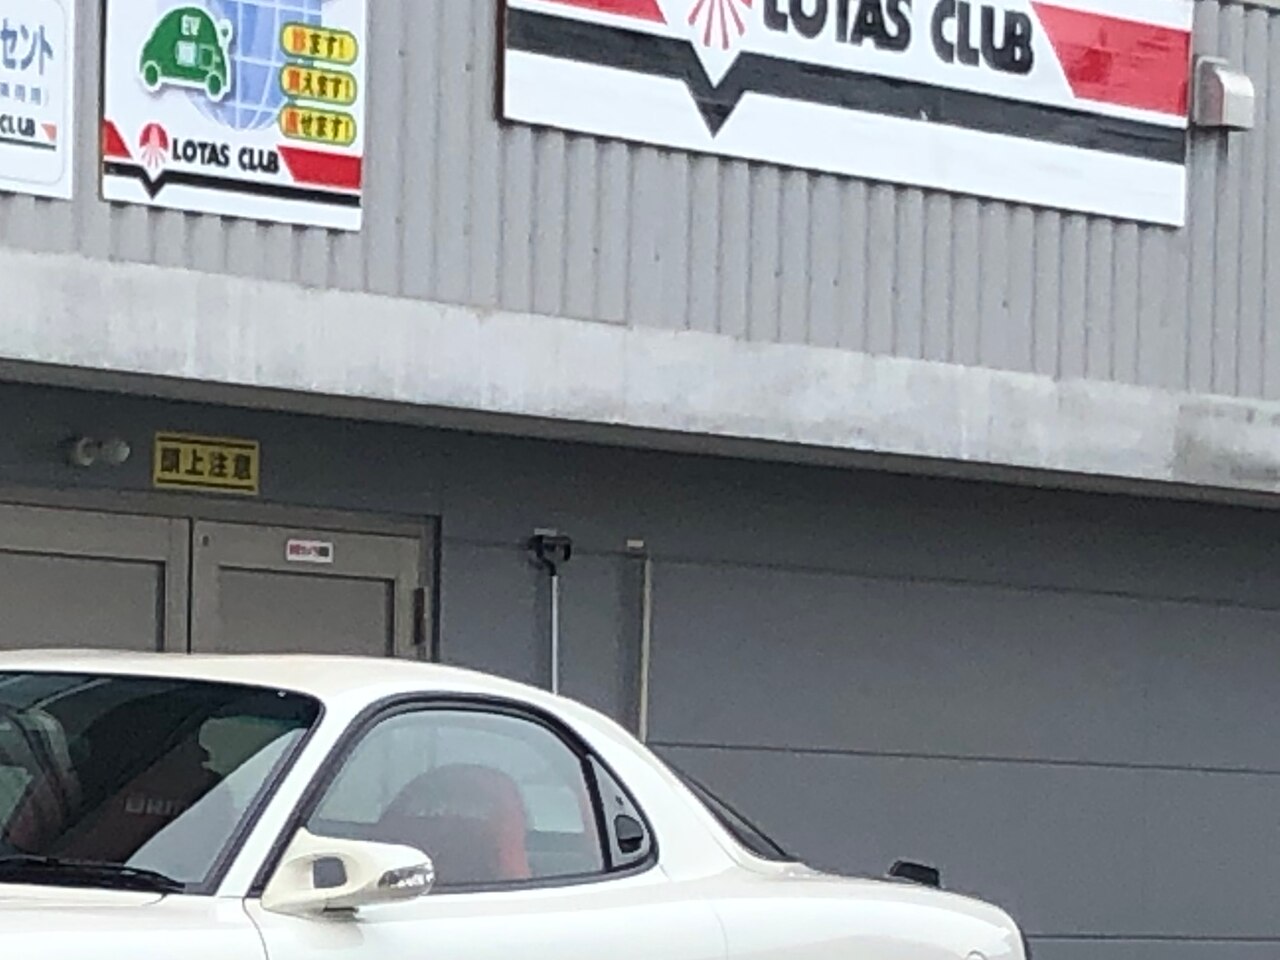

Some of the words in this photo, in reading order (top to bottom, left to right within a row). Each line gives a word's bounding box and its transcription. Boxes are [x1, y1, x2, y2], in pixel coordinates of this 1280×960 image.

[180, 14, 202, 36] EV
[763, 0, 912, 52] LOTAS
[930, 0, 1035, 76] CLUB
[172, 138, 230, 167] LOTAS
[237, 147, 280, 174] CLUB
[160, 447, 252, 480] 頭上注意
